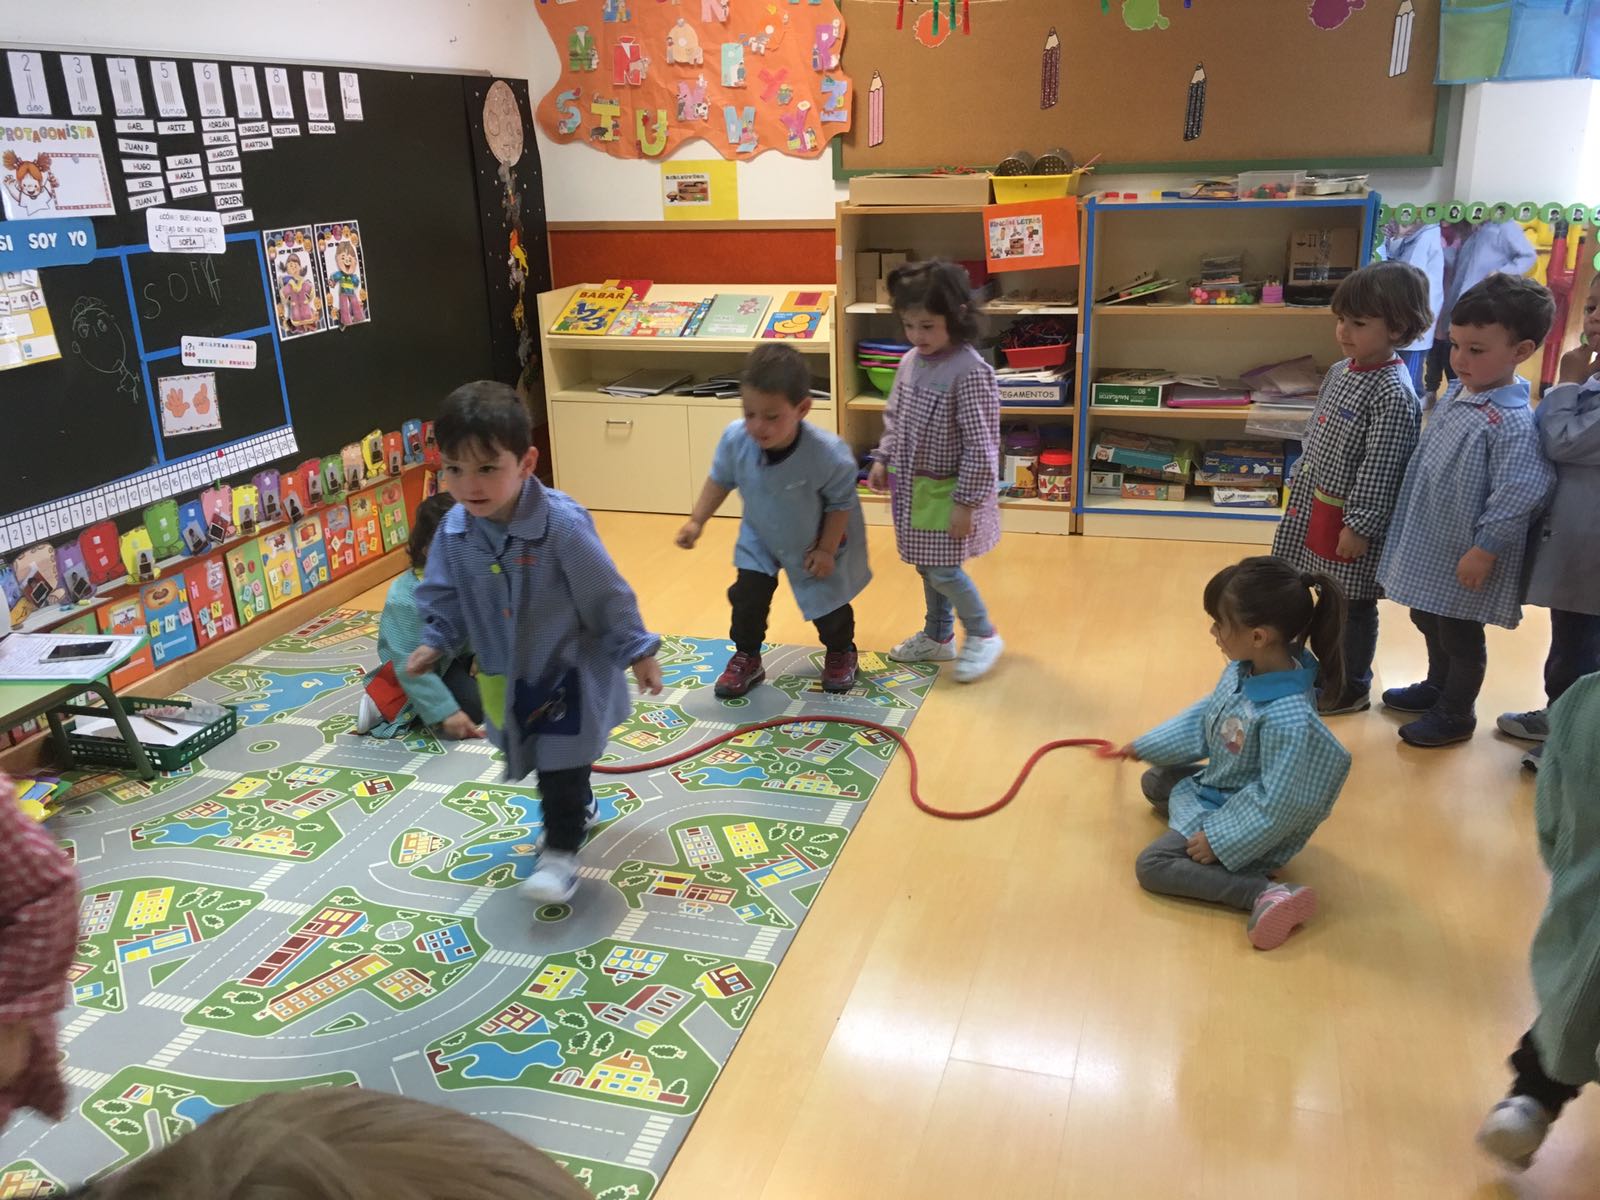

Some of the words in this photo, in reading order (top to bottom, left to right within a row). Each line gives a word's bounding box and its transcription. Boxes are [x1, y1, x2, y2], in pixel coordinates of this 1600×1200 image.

[21, 54, 31, 72] 2
[73, 57, 82, 74] 3
[117, 60, 126, 75] 4
[161, 63, 169, 78] 5
[203, 64, 211, 79] 6
[240, 68, 248, 82] 7
[273, 69, 280, 83] 8
[311, 73, 318, 85] 9
[127, 122, 144, 130] GAEL
[556, 87, 582, 135] S
[636, 109, 668, 156] U
[0, 123, 95, 143] PROTAGONISTA
[167, 124, 186, 132] ARITZ
[241, 124, 266, 134] ENRIQUE
[209, 134, 231, 142] SAMUEL
[124, 142, 143, 151] JUAN
[244, 140, 269, 148] MARTINA
[212, 150, 234, 159] MARCOS
[174, 158, 192, 166] LAURA
[216, 164, 235, 172] OLIVIA
[138, 180, 154, 188] IKER
[135, 196, 152, 206] JUAN
[28, 232, 58, 250] SOY
[68, 230, 88, 247] YO
[579, 291, 625, 299] BABAR
[577, 302, 587, 315] 1
[577, 309, 600, 322] 2
[585, 316, 606, 330] 3
[12, 529, 19, 540] 2
[26, 525, 32, 536] 3
[38, 521, 44, 530] 4
[50, 517, 57, 528] 5
[62, 512, 69, 524] 6
[85, 506, 92, 516] 8
[97, 502, 103, 512] 9
[108, 497, 118, 508] 10
[130, 491, 138, 501] 12
[141, 487, 149, 498] 13
[371, 505, 378, 517] S
[181, 610, 190, 620] N
[152, 624, 158, 633] N
[167, 619, 173, 628] N
[156, 645, 162, 655] N
